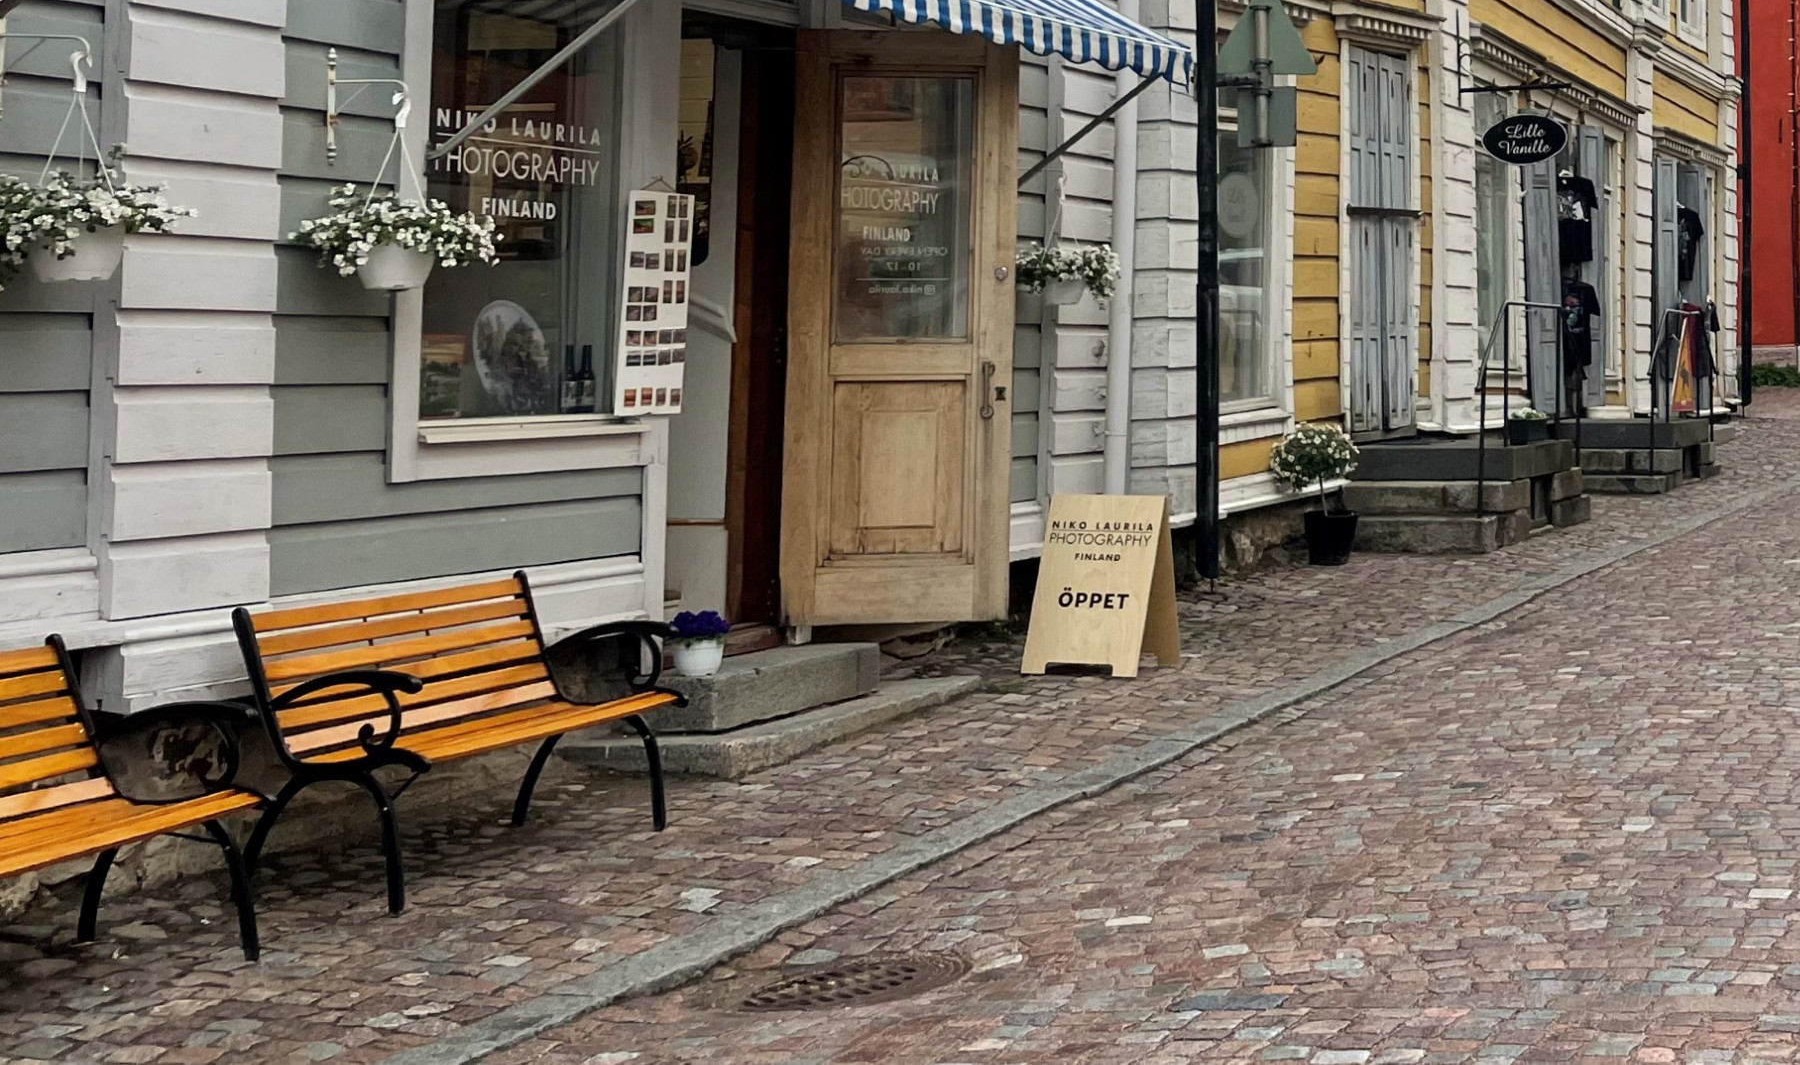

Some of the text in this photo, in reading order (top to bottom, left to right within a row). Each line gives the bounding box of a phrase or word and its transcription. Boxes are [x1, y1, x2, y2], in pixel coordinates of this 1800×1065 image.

[512, 118, 600, 145] LAURILA
[1505, 123, 1546, 139] Lille
[1498, 139, 1552, 155] Vanille
[482, 197, 556, 220] FINLAND
[842, 187, 939, 214] HOTOGRAPHY
[863, 226, 911, 242] FINLAND
[1052, 520, 1153, 531] NIKO LAURILA
[1049, 533, 1152, 547] PHOTOGRAPHY
[1074, 553, 1121, 562] FINLAND
[1058, 587, 1130, 609] ÖPPET
